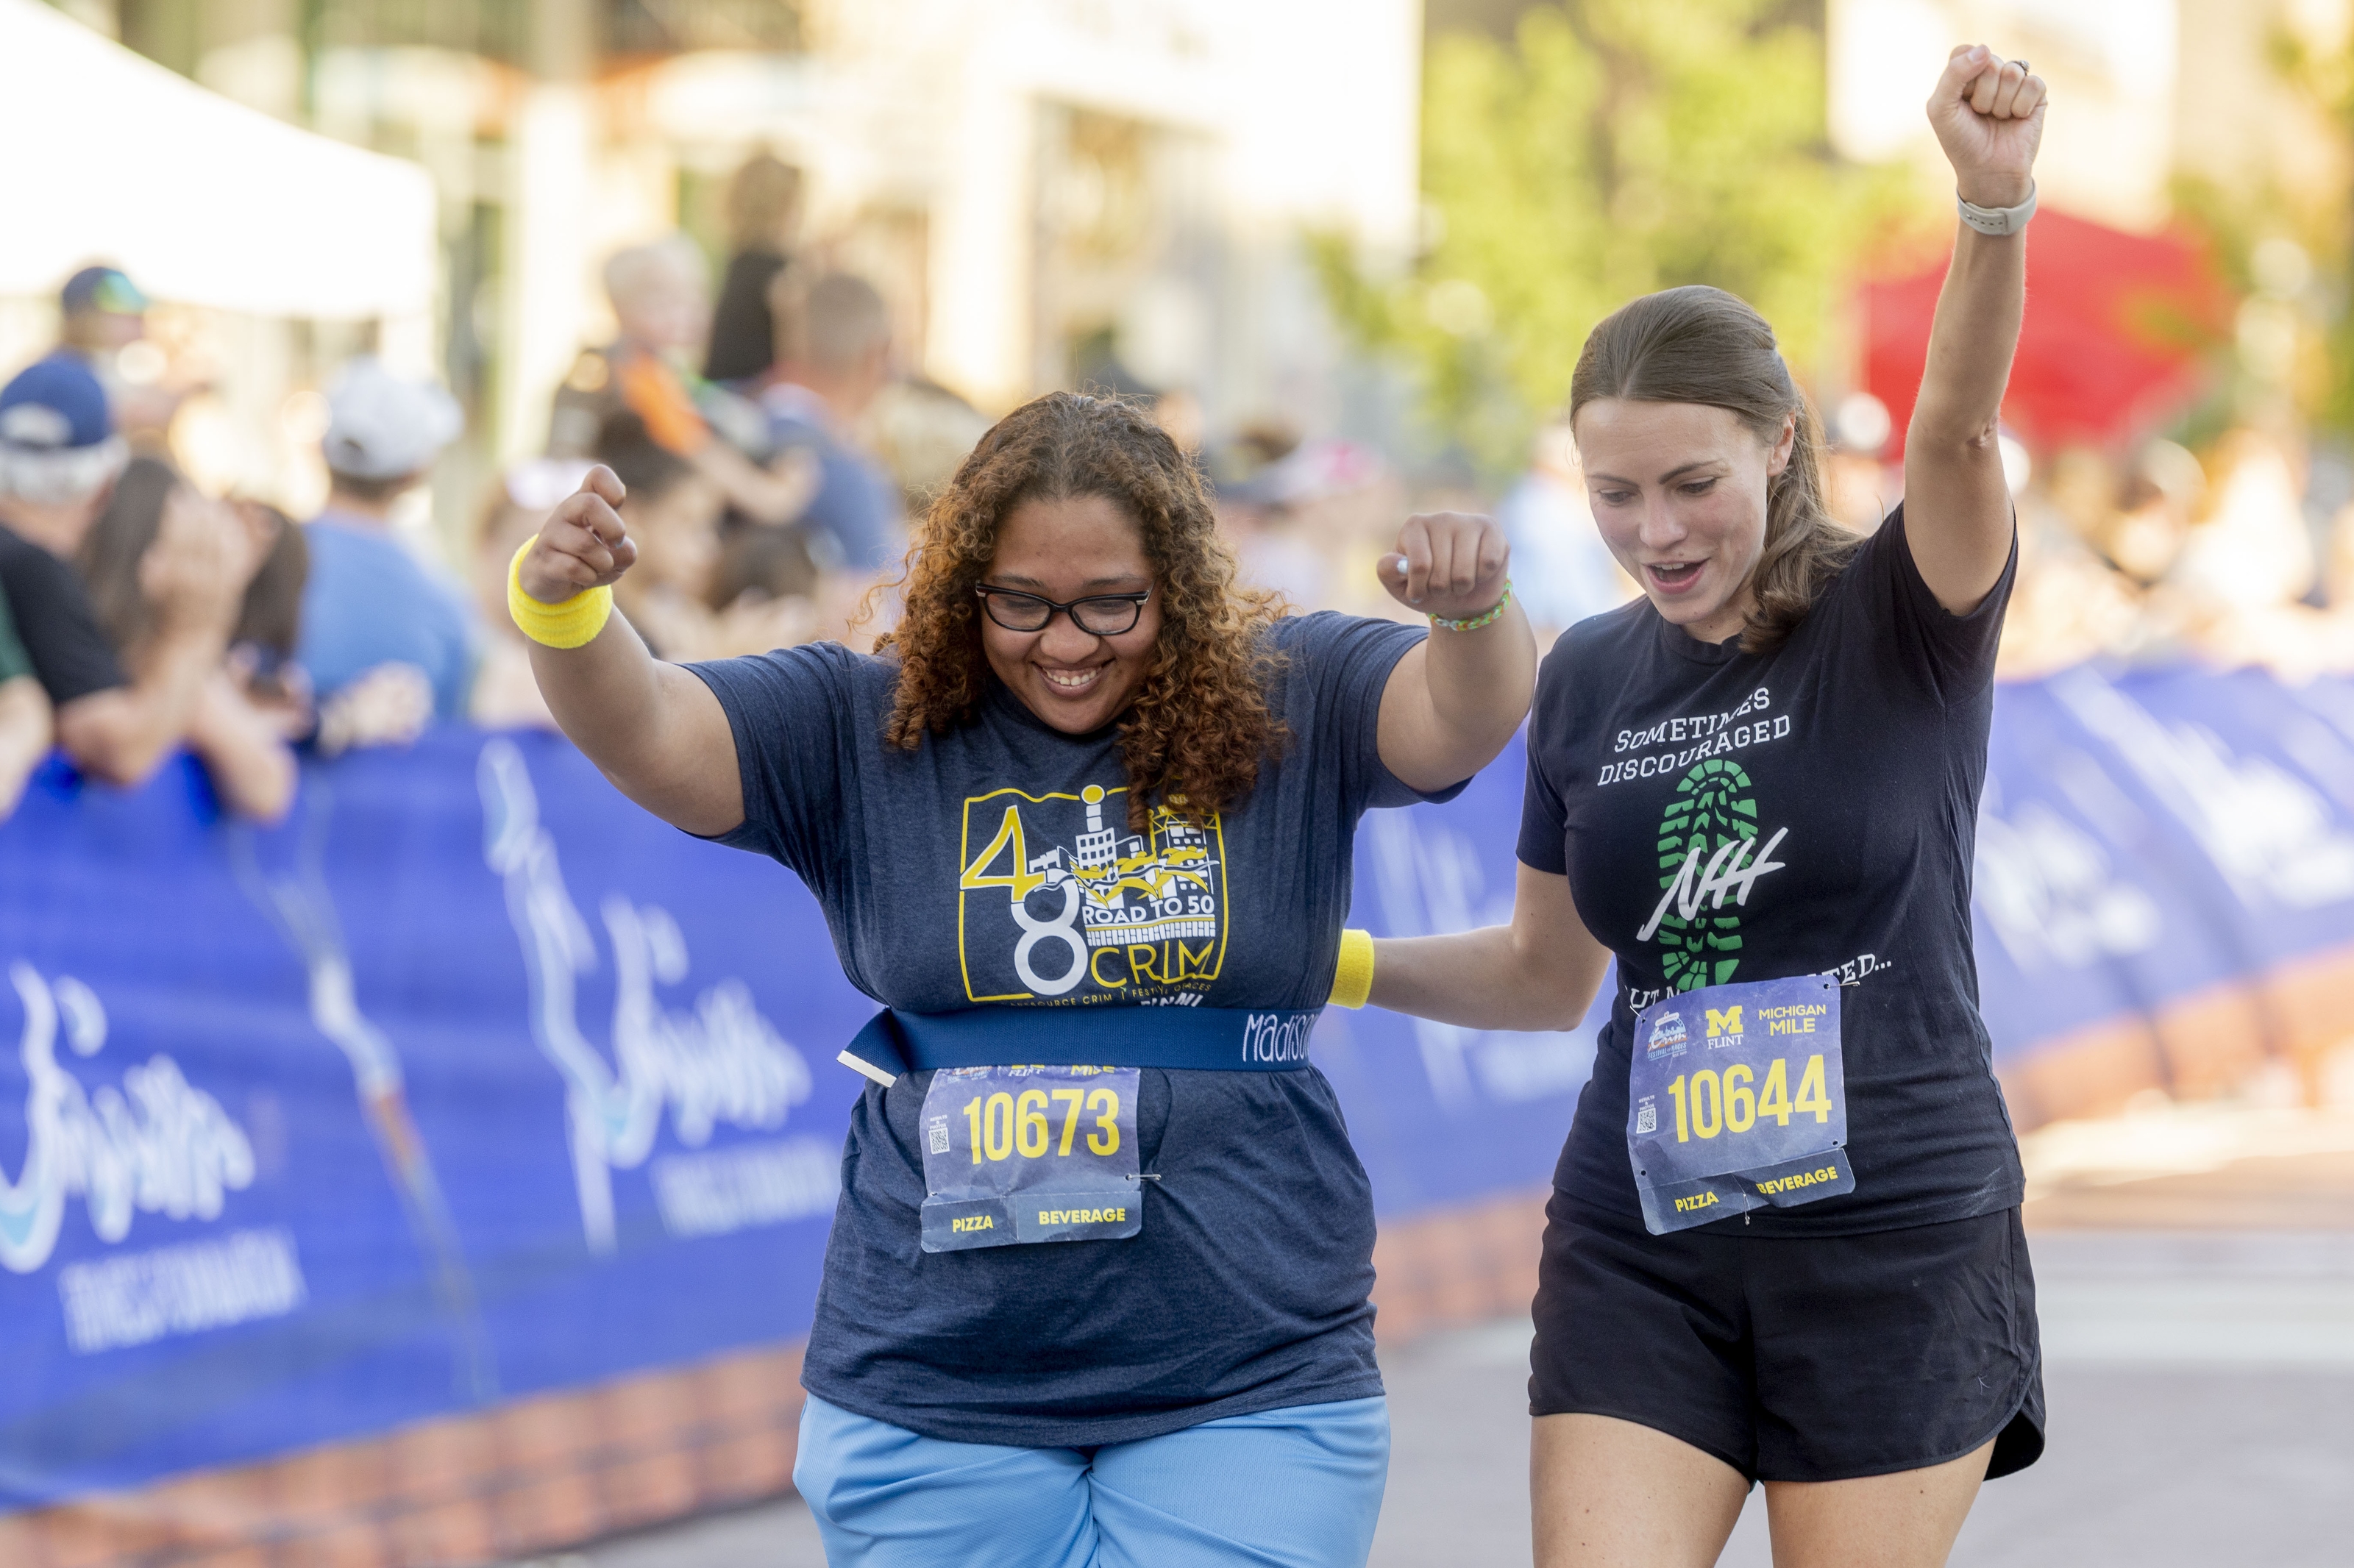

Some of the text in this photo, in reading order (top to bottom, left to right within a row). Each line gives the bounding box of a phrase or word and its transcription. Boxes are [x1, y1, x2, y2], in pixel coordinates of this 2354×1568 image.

[1614, 687, 1770, 752] SOMETIMES
[1597, 715, 1791, 786] DISCOURAGED
[1082, 895, 1215, 924] ROAD TO 50
[1090, 939, 1215, 988] CRIM
[1082, 994, 1112, 1005] CRIM
[1624, 986, 1660, 1009] UT
[1705, 1005, 1743, 1038] M
[1758, 1005, 1827, 1021] MICHIGAN
[1769, 1018, 1816, 1036] MILE
[1648, 1047, 1668, 1059] FESTIVAL
[1707, 1034, 1744, 1050] FLINT
[1008, 1069, 1045, 1077] FLINT
[1668, 1054, 1832, 1143] 10644
[964, 1088, 1120, 1165] 10673
[1674, 1166, 1838, 1212] PIZZA BEVERAGE
[952, 1207, 1126, 1233] PIZZA BEVERAGE
